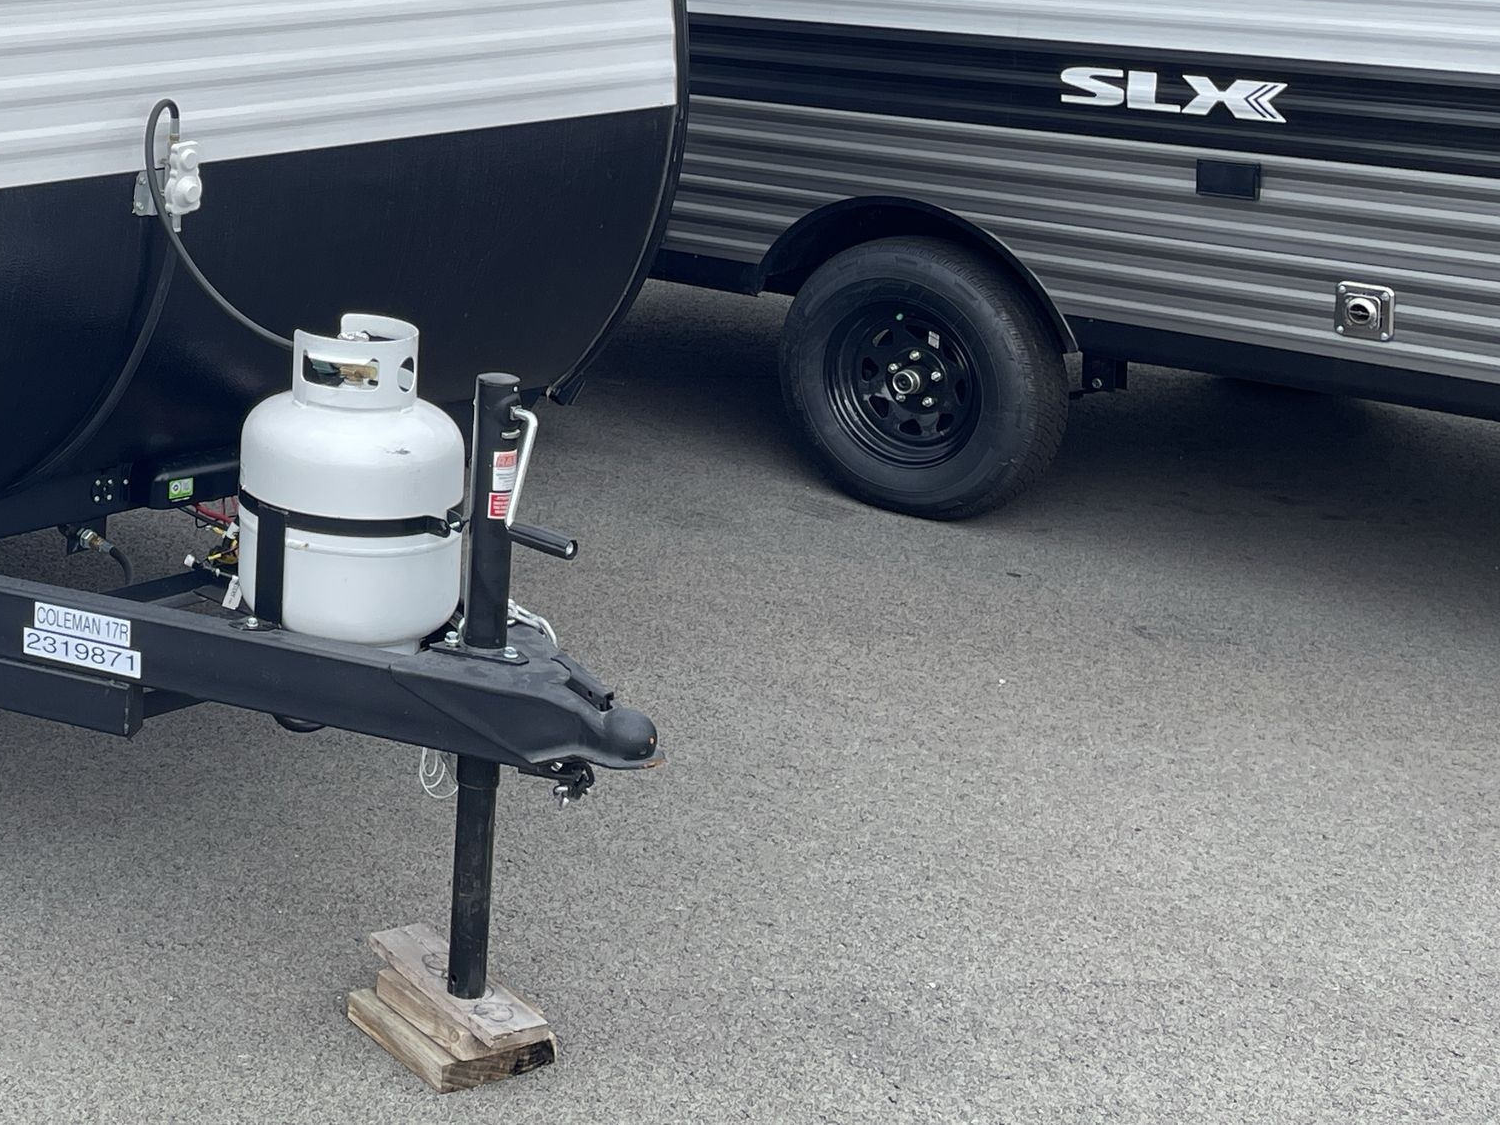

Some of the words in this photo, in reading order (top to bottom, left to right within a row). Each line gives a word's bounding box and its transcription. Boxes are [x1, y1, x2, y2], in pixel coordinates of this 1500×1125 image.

[1060, 66, 1288, 124] SLX
[36, 606, 101, 636] COLEMAN
[105, 621, 129, 642] 17R
[26, 632, 135, 672] 2319871
